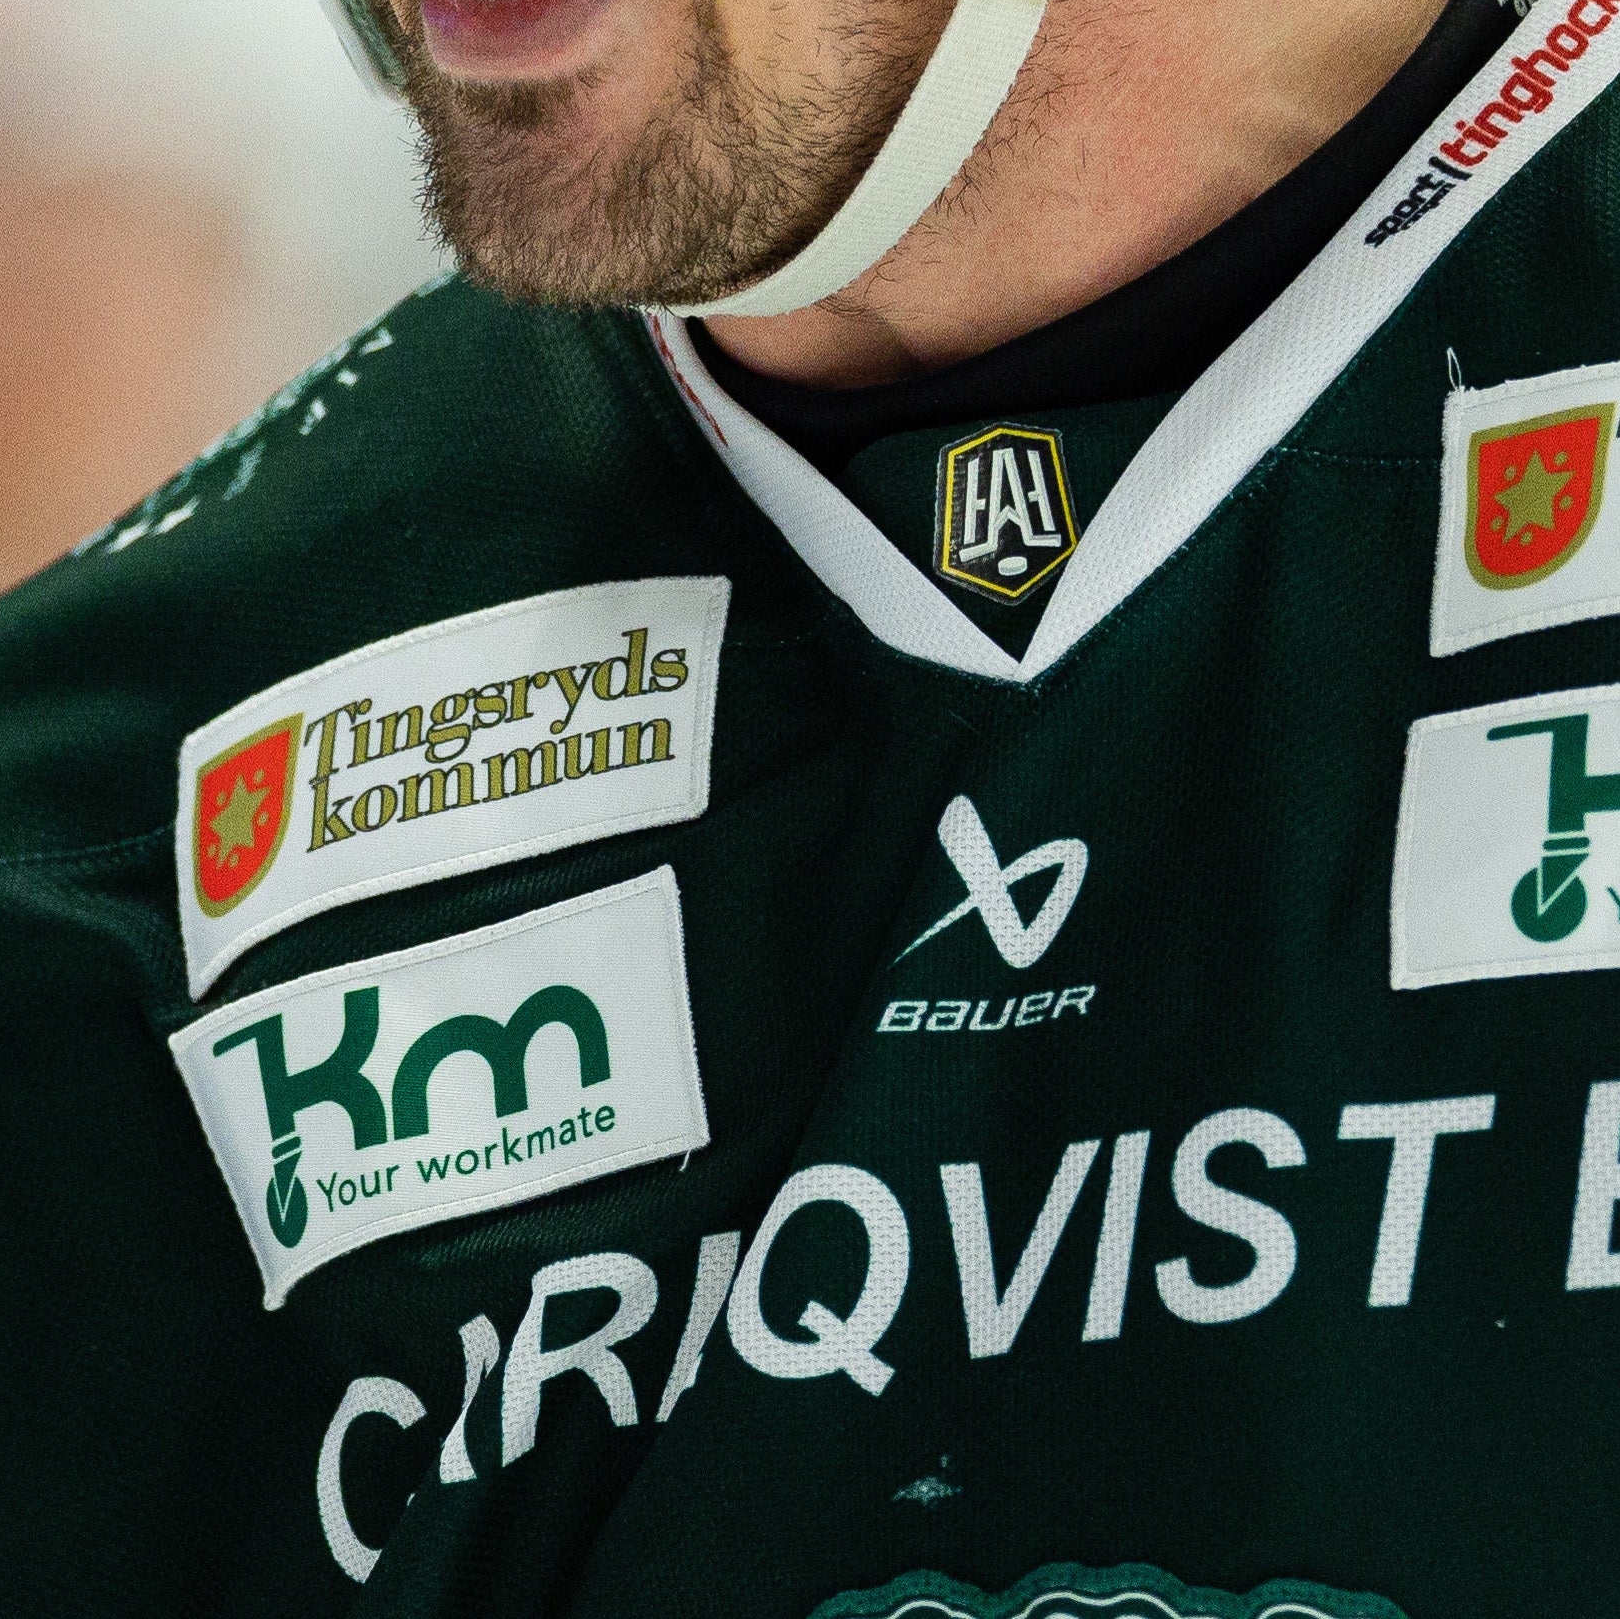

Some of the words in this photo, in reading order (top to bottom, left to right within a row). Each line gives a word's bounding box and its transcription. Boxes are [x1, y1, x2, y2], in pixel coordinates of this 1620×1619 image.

[304, 627, 690, 784] Tingsryds
[306, 716, 675, 854] kommun
[315, 1163, 401, 1214] Your
[415, 1104, 617, 1184] workmate
